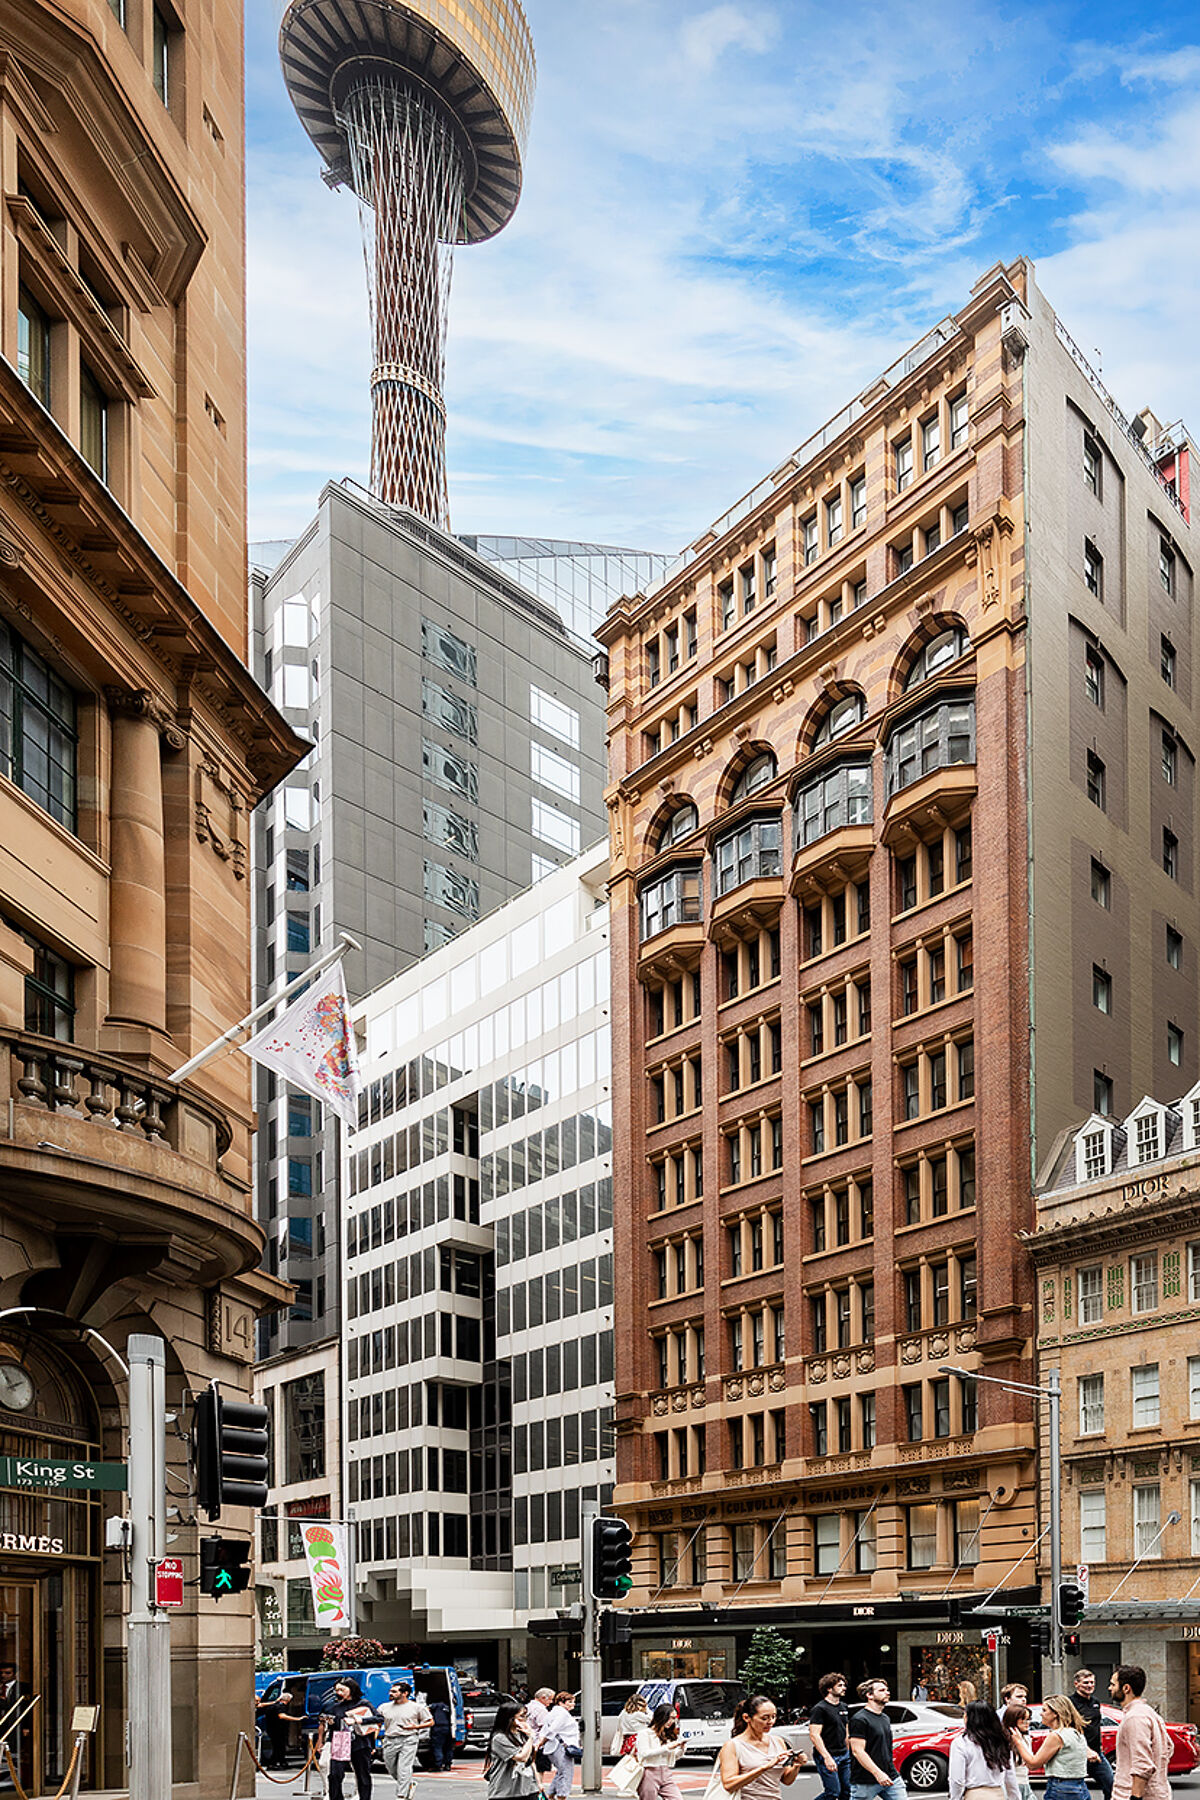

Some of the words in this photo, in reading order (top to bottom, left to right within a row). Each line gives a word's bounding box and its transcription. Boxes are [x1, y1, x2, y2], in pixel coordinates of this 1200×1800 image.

[1122, 1175, 1169, 1201] DIOR
[225, 1305, 251, 1349] 14
[16, 1461, 67, 1482] King
[72, 1464, 95, 1479] St
[809, 1485, 875, 1504] CHAMBERS
[0, 1532, 64, 1555] RMÈS
[164, 1561, 177, 1570] NO
[853, 1606, 875, 1616] DIOR
[936, 1632, 964, 1644] DIOR
[1182, 1626, 1200, 1638] DI
